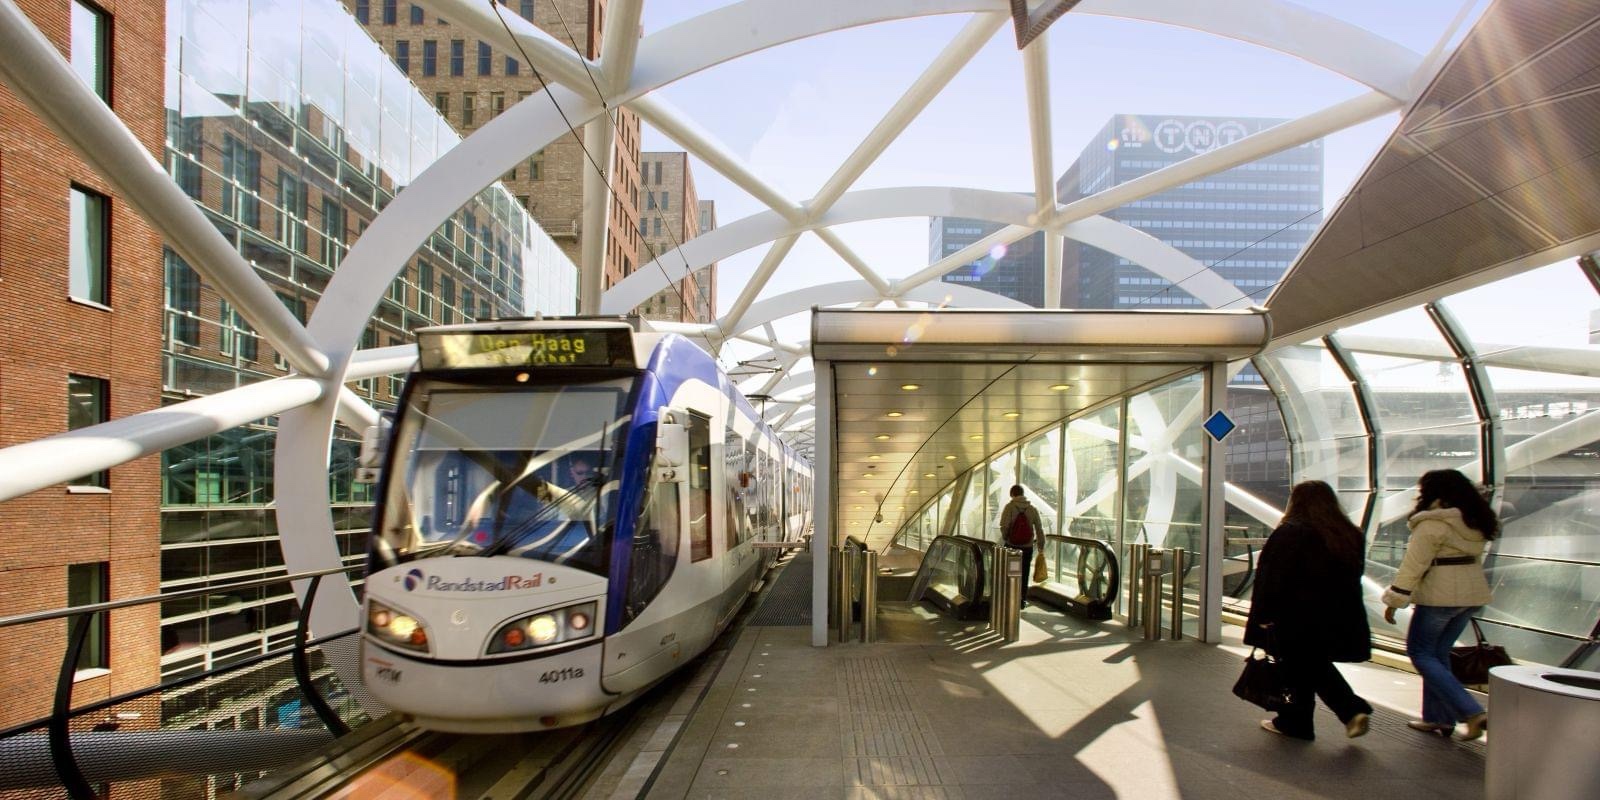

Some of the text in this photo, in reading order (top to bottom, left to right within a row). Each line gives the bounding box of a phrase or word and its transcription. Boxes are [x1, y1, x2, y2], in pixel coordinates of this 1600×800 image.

[1154, 119, 1247, 153] TNT
[532, 334, 586, 353] Haag
[426, 572, 543, 592] RandstadRail
[538, 667, 585, 685] 4011a
